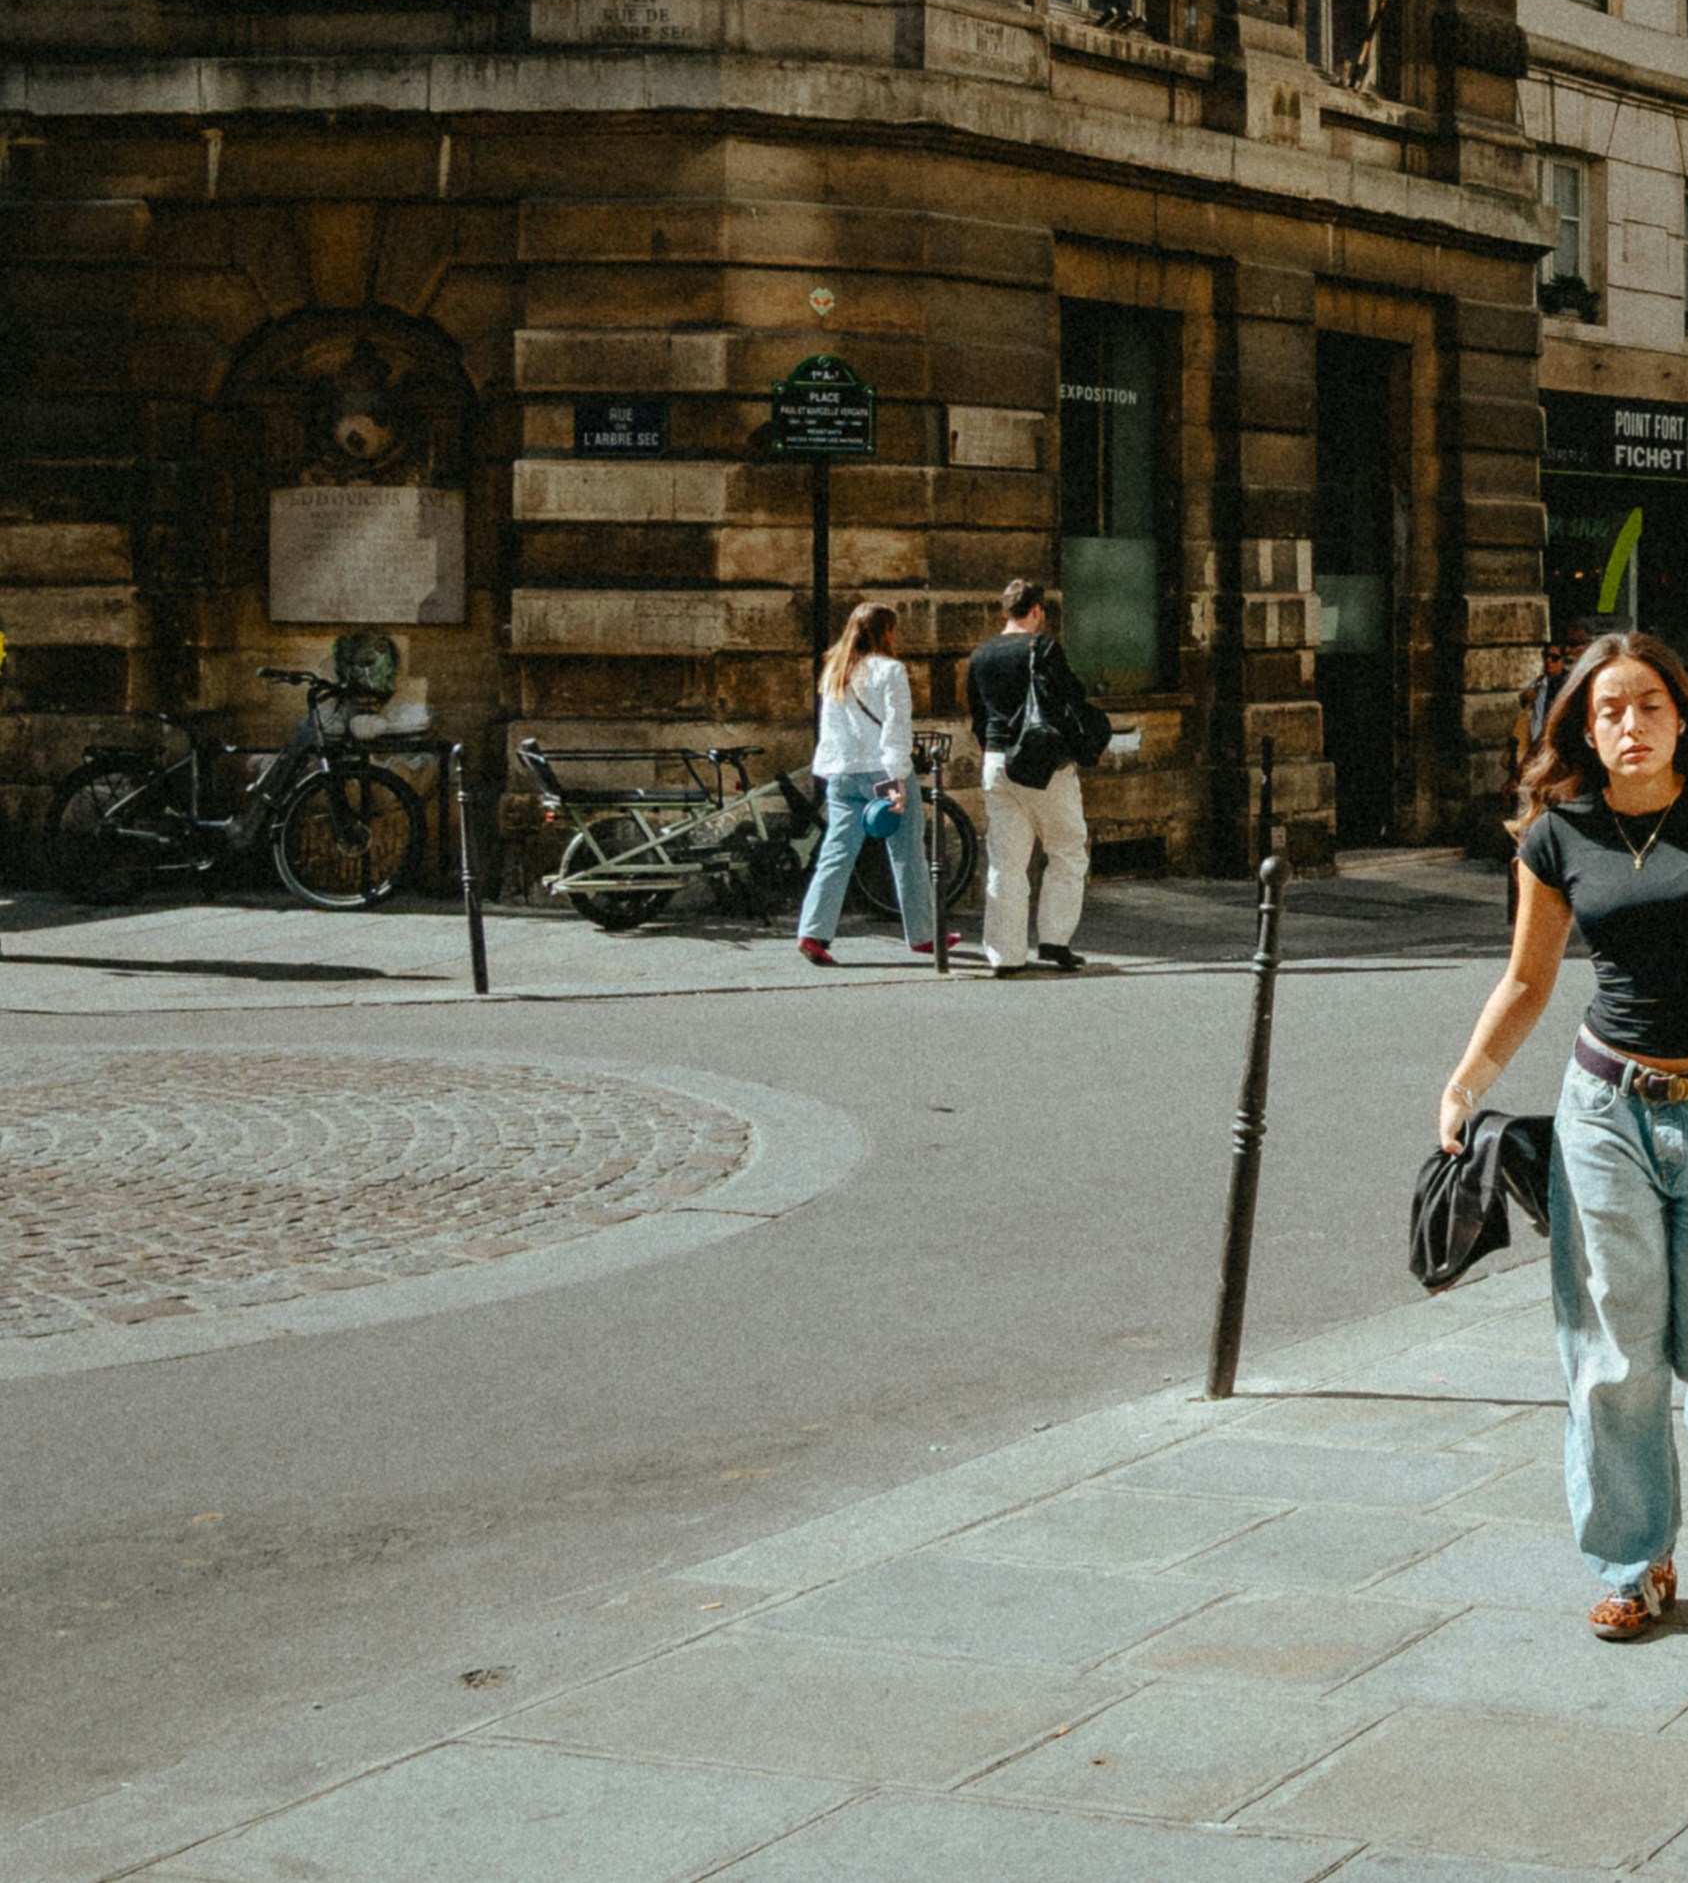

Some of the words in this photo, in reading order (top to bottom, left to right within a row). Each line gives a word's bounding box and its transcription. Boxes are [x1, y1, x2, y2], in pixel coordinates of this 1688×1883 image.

[809, 392, 841, 403] PLACE
[1059, 383, 1138, 405] EXPOSITION
[609, 408, 633, 422] RUE
[1615, 409, 1652, 438] POINT
[1654, 413, 1685, 441] FORT
[583, 432, 633, 446] L'ARBRE
[637, 432, 660, 446] SEC
